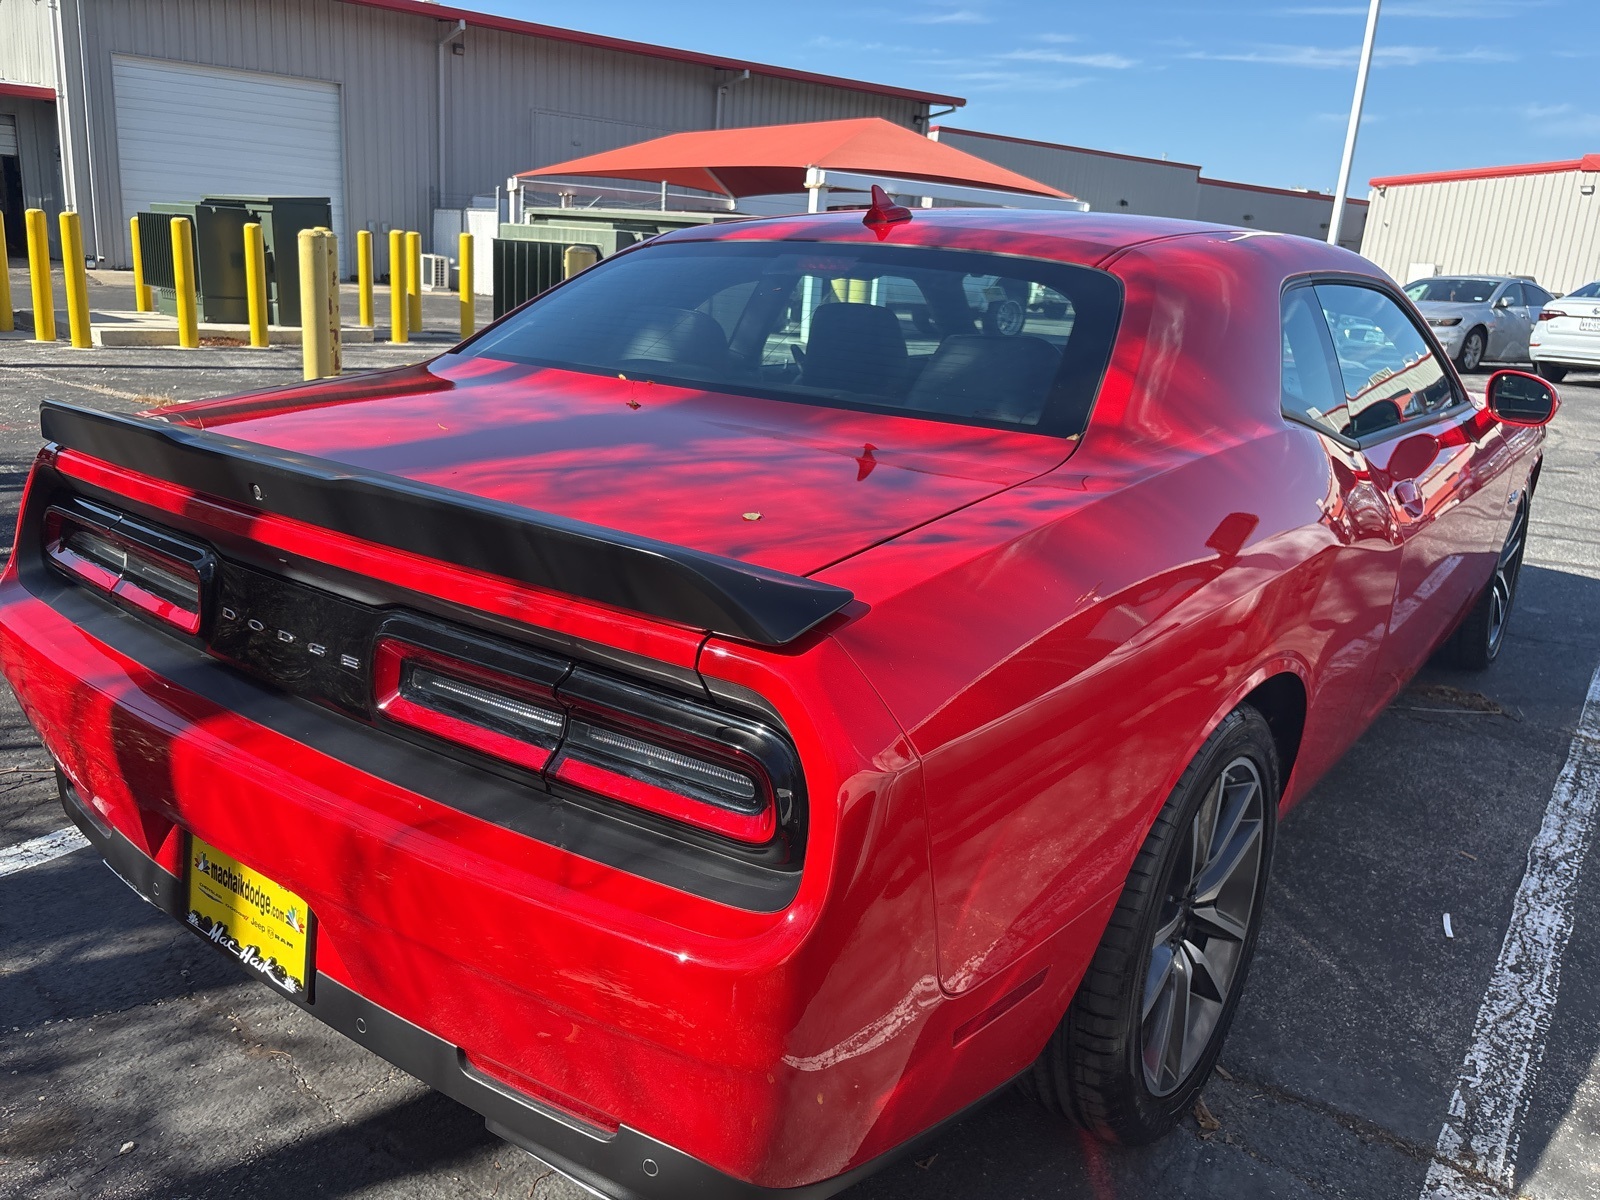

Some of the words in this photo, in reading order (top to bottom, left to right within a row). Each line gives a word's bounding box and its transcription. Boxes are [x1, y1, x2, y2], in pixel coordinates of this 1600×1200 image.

[222, 606, 361, 670] DODGE
[210, 862, 284, 922] machaikdodge.com
[251, 917, 266, 933] Jeep
[274, 933, 294, 949] RAM
